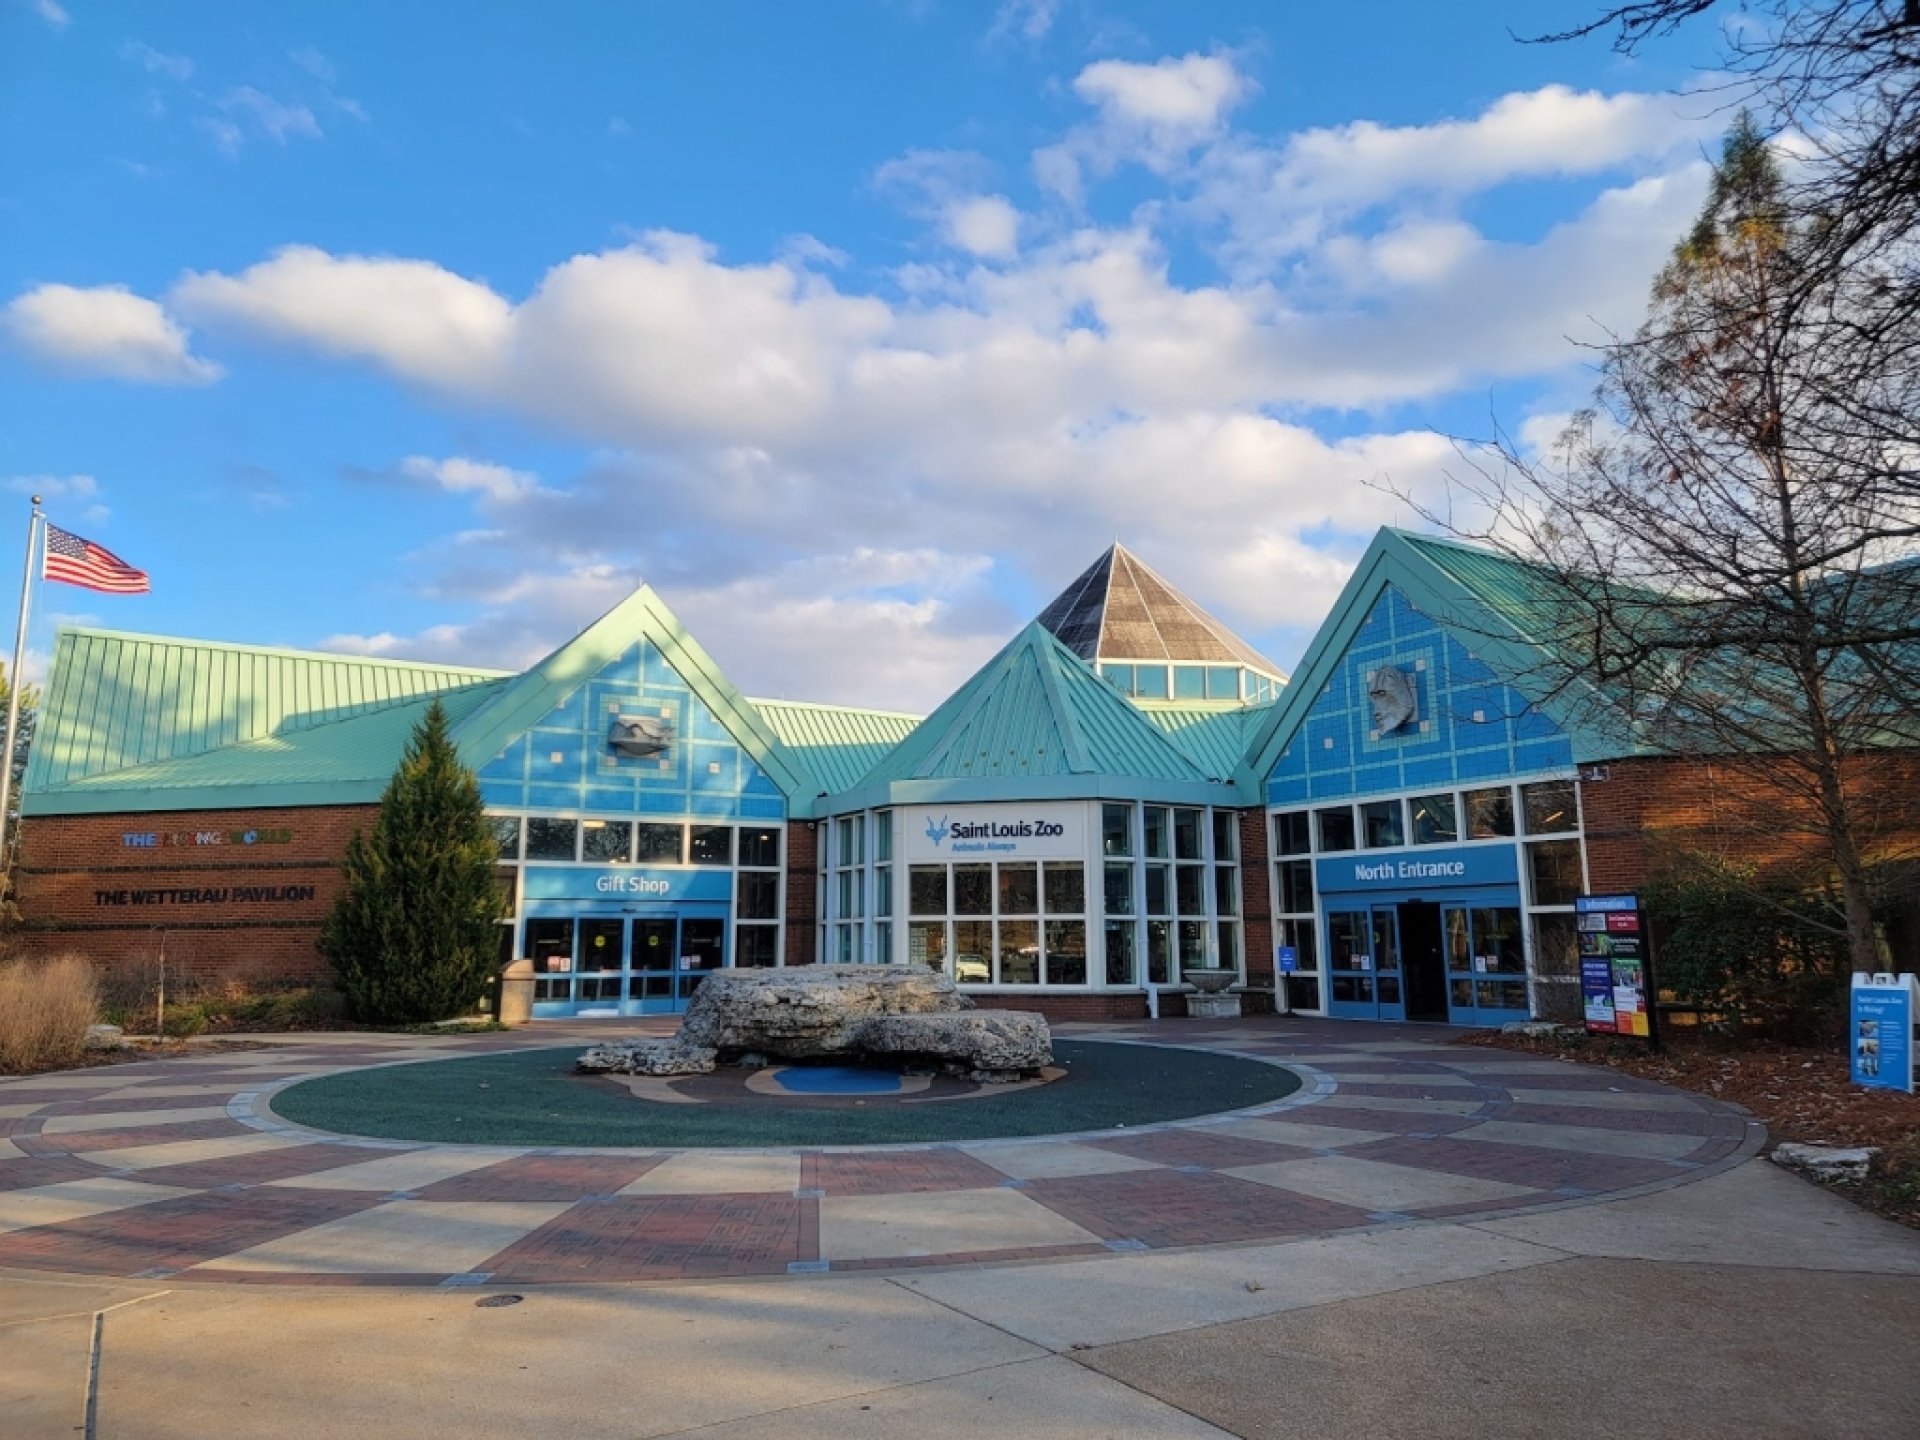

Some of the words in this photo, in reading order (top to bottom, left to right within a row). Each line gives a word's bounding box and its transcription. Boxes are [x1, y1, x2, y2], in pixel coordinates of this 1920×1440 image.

[950, 821, 991, 839] Saint
[991, 820, 1032, 838] Louis
[1034, 820, 1064, 837] Zoo
[122, 832, 157, 848] THE
[1355, 862, 1395, 881] North
[1399, 861, 1465, 879] Entrance
[94, 889, 128, 906] THE
[131, 887, 227, 905] WETTERAU
[231, 886, 315, 903] PAVILION
[597, 876, 626, 892] Gift
[629, 877, 669, 896] Shop
